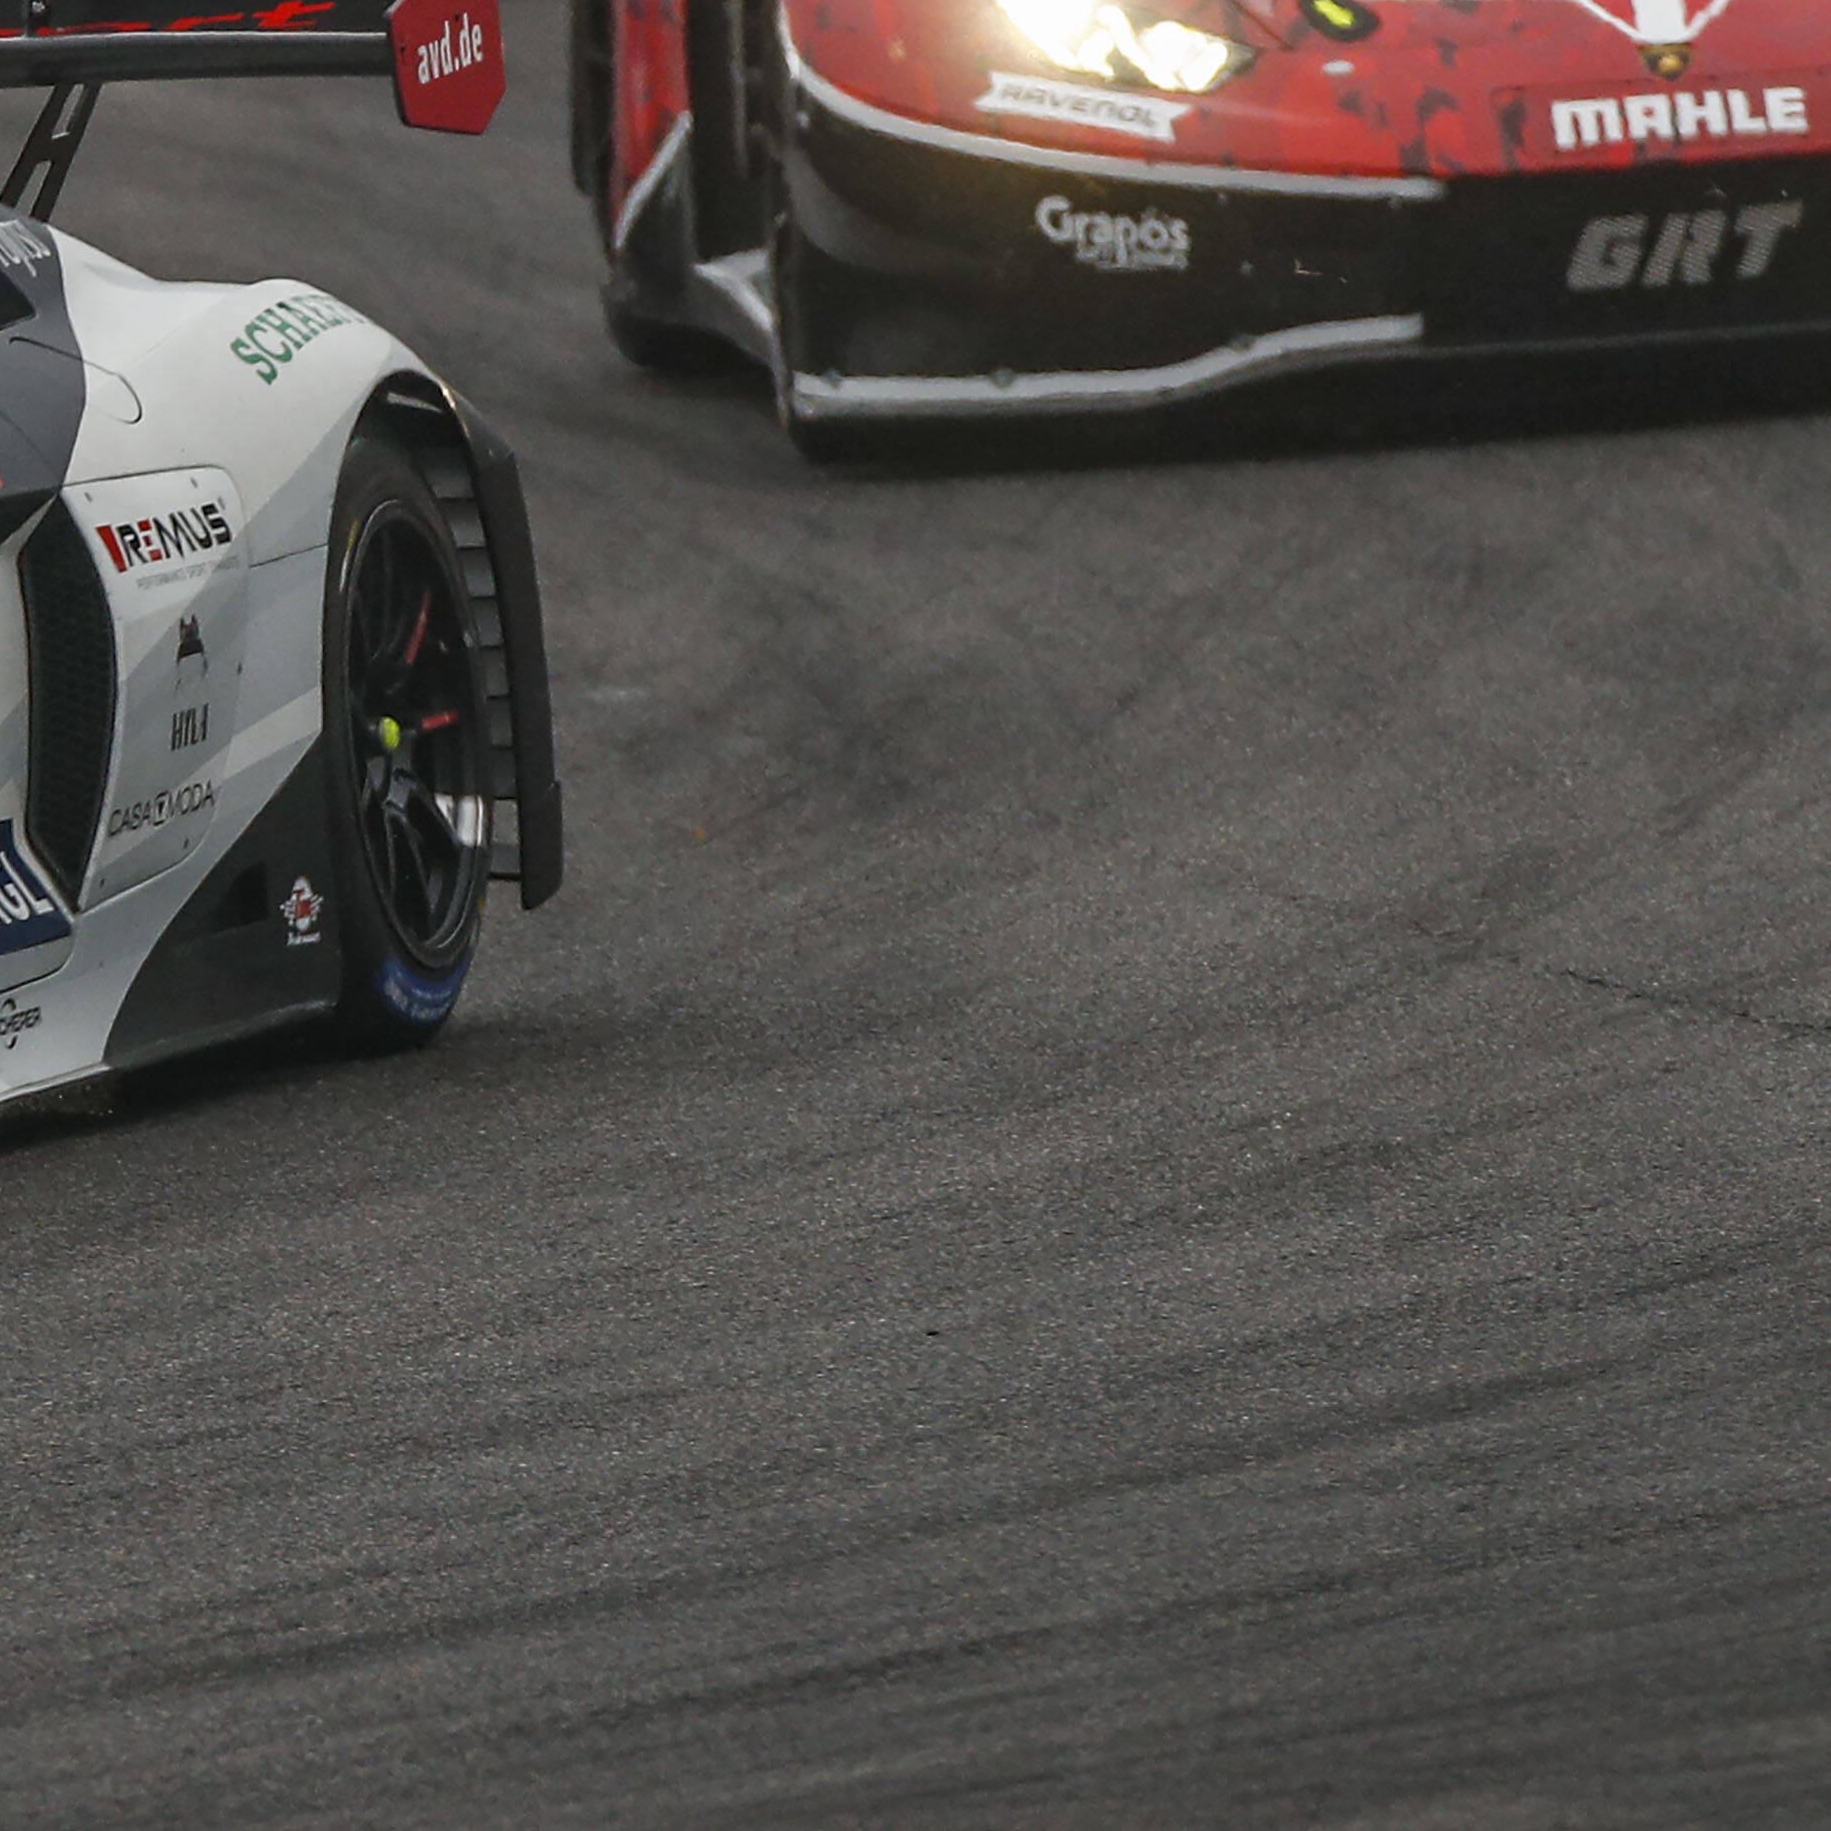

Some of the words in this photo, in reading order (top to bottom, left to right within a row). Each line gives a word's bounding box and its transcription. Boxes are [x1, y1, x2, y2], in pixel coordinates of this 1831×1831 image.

[417, 12, 484, 85] avd.de
[1550, 86, 1809, 152] MAHLE
[1565, 201, 1805, 294] GRT
[115, 502, 232, 567] REMUS
